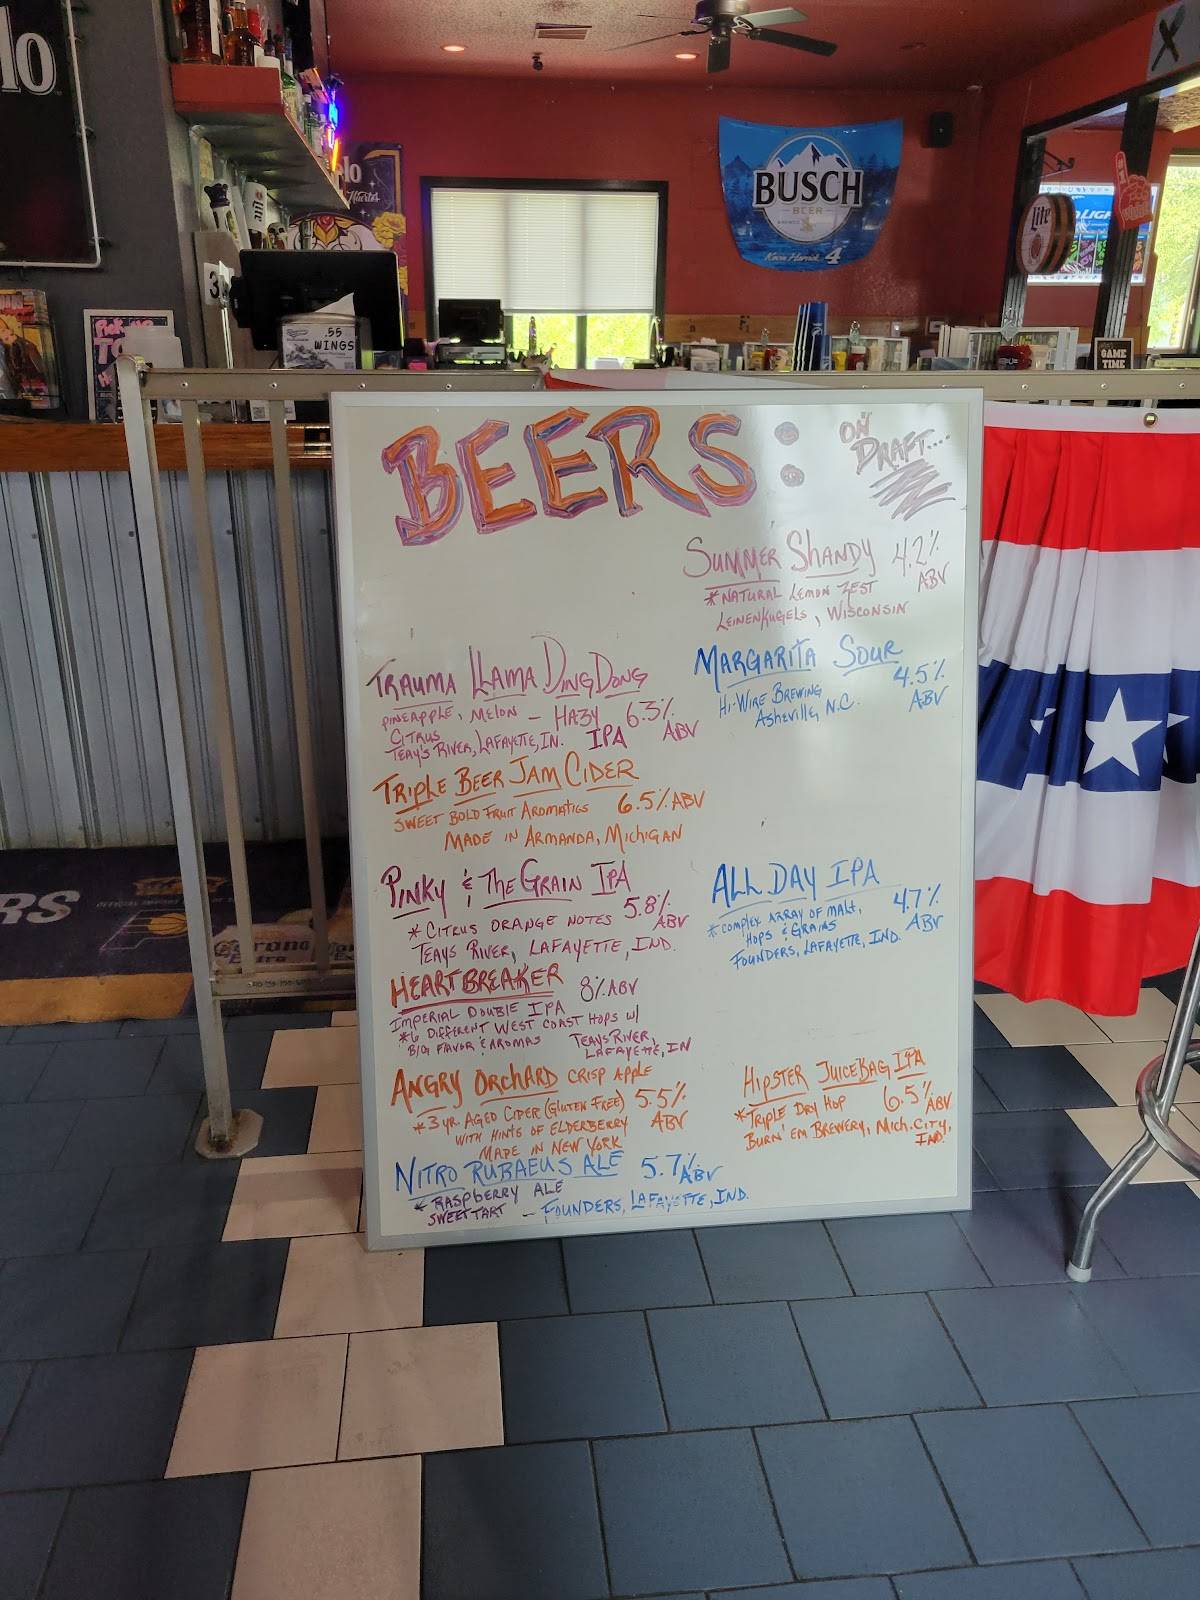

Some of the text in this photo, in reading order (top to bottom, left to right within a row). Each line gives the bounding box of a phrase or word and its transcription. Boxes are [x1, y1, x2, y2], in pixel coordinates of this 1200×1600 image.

[754, 170, 862, 206] BUSCH
[792, 206, 824, 215] BEER
[1029, 206, 1052, 232] Lite
[825, 247, 846, 265] 4
[314, 340, 354, 351] WINGS
[1100, 348, 1127, 359] GAME
[1101, 359, 1126, 369] TIME
[682, 535, 781, 580] SUMMER
[789, 583, 831, 602] LEMON
[917, 562, 950, 593] ABV
[826, 600, 909, 621] WISCONSIN
[694, 633, 904, 693] MARGARITA SOUR
[893, 658, 946, 688] 4.5%
[366, 658, 457, 701] TRAUMA
[771, 681, 823, 704] BREWING
[626, 697, 675, 729] 6.3%
[908, 685, 949, 712] ABV
[390, 727, 441, 746] CITRUS
[585, 719, 701, 751] IPA ABV
[372, 750, 640, 812] TRIPLE BEER JAM CIDER
[393, 811, 445, 833] SWEET
[448, 808, 481, 826] BOLD
[483, 804, 517, 820] FRUIT
[617, 786, 670, 815] 6.5%
[671, 790, 706, 812] ABV
[444, 830, 493, 853] MADE
[504, 829, 519, 844] IN
[604, 822, 683, 854] MICHIGAN
[380, 865, 447, 919] PINKY
[478, 867, 516, 901] THE
[520, 858, 583, 899] GRAIN
[590, 860, 631, 897] IPA
[711, 856, 881, 908] ALL DAY IPA
[491, 915, 556, 932] ORANGE
[566, 913, 613, 928] NOTES
[623, 889, 672, 919] 5.8%
[768, 908, 804, 926] ARRAY
[808, 907, 824, 918] OF
[892, 882, 942, 914] 4.7%
[652, 913, 690, 932] ABV
[746, 930, 773, 948] HOPS
[791, 919, 837, 938] GRAINS
[905, 913, 944, 932] ABV
[411, 943, 457, 967] TEAYS
[390, 962, 639, 1008] HEARTBREAKER 8% ABV
[389, 1006, 461, 1033] IMPERIAL
[528, 999, 566, 1018] IPA
[493, 1018, 536, 1034] WEST
[541, 1014, 585, 1030] COAST
[588, 1010, 620, 1029] HOPS
[488, 1035, 542, 1051] AROMAS
[666, 1037, 692, 1054] IN
[390, 1062, 654, 1114] ANGRY ORCHARD CRISP APPLE
[743, 1064, 810, 1103] HIPSTER
[892, 1046, 927, 1073] IPA
[464, 1111, 499, 1130] AGED
[503, 1103, 543, 1123] CIDER
[634, 1080, 687, 1110] 5.5%
[794, 1101, 818, 1119] DRY
[824, 1094, 846, 1112] HOP
[882, 1080, 933, 1112] 6.5%
[925, 1091, 953, 1115] ABV
[454, 1109, 688, 1146] WITH HINTS OF ELDERBERRY ABV
[479, 1135, 624, 1161] MADE IN NEW YORK
[394, 1150, 697, 1196] NITRO RUBAEUS ALE 5.7%
[679, 1164, 724, 1186] ABV
[430, 1179, 565, 1210] RASPBERRY ALE
